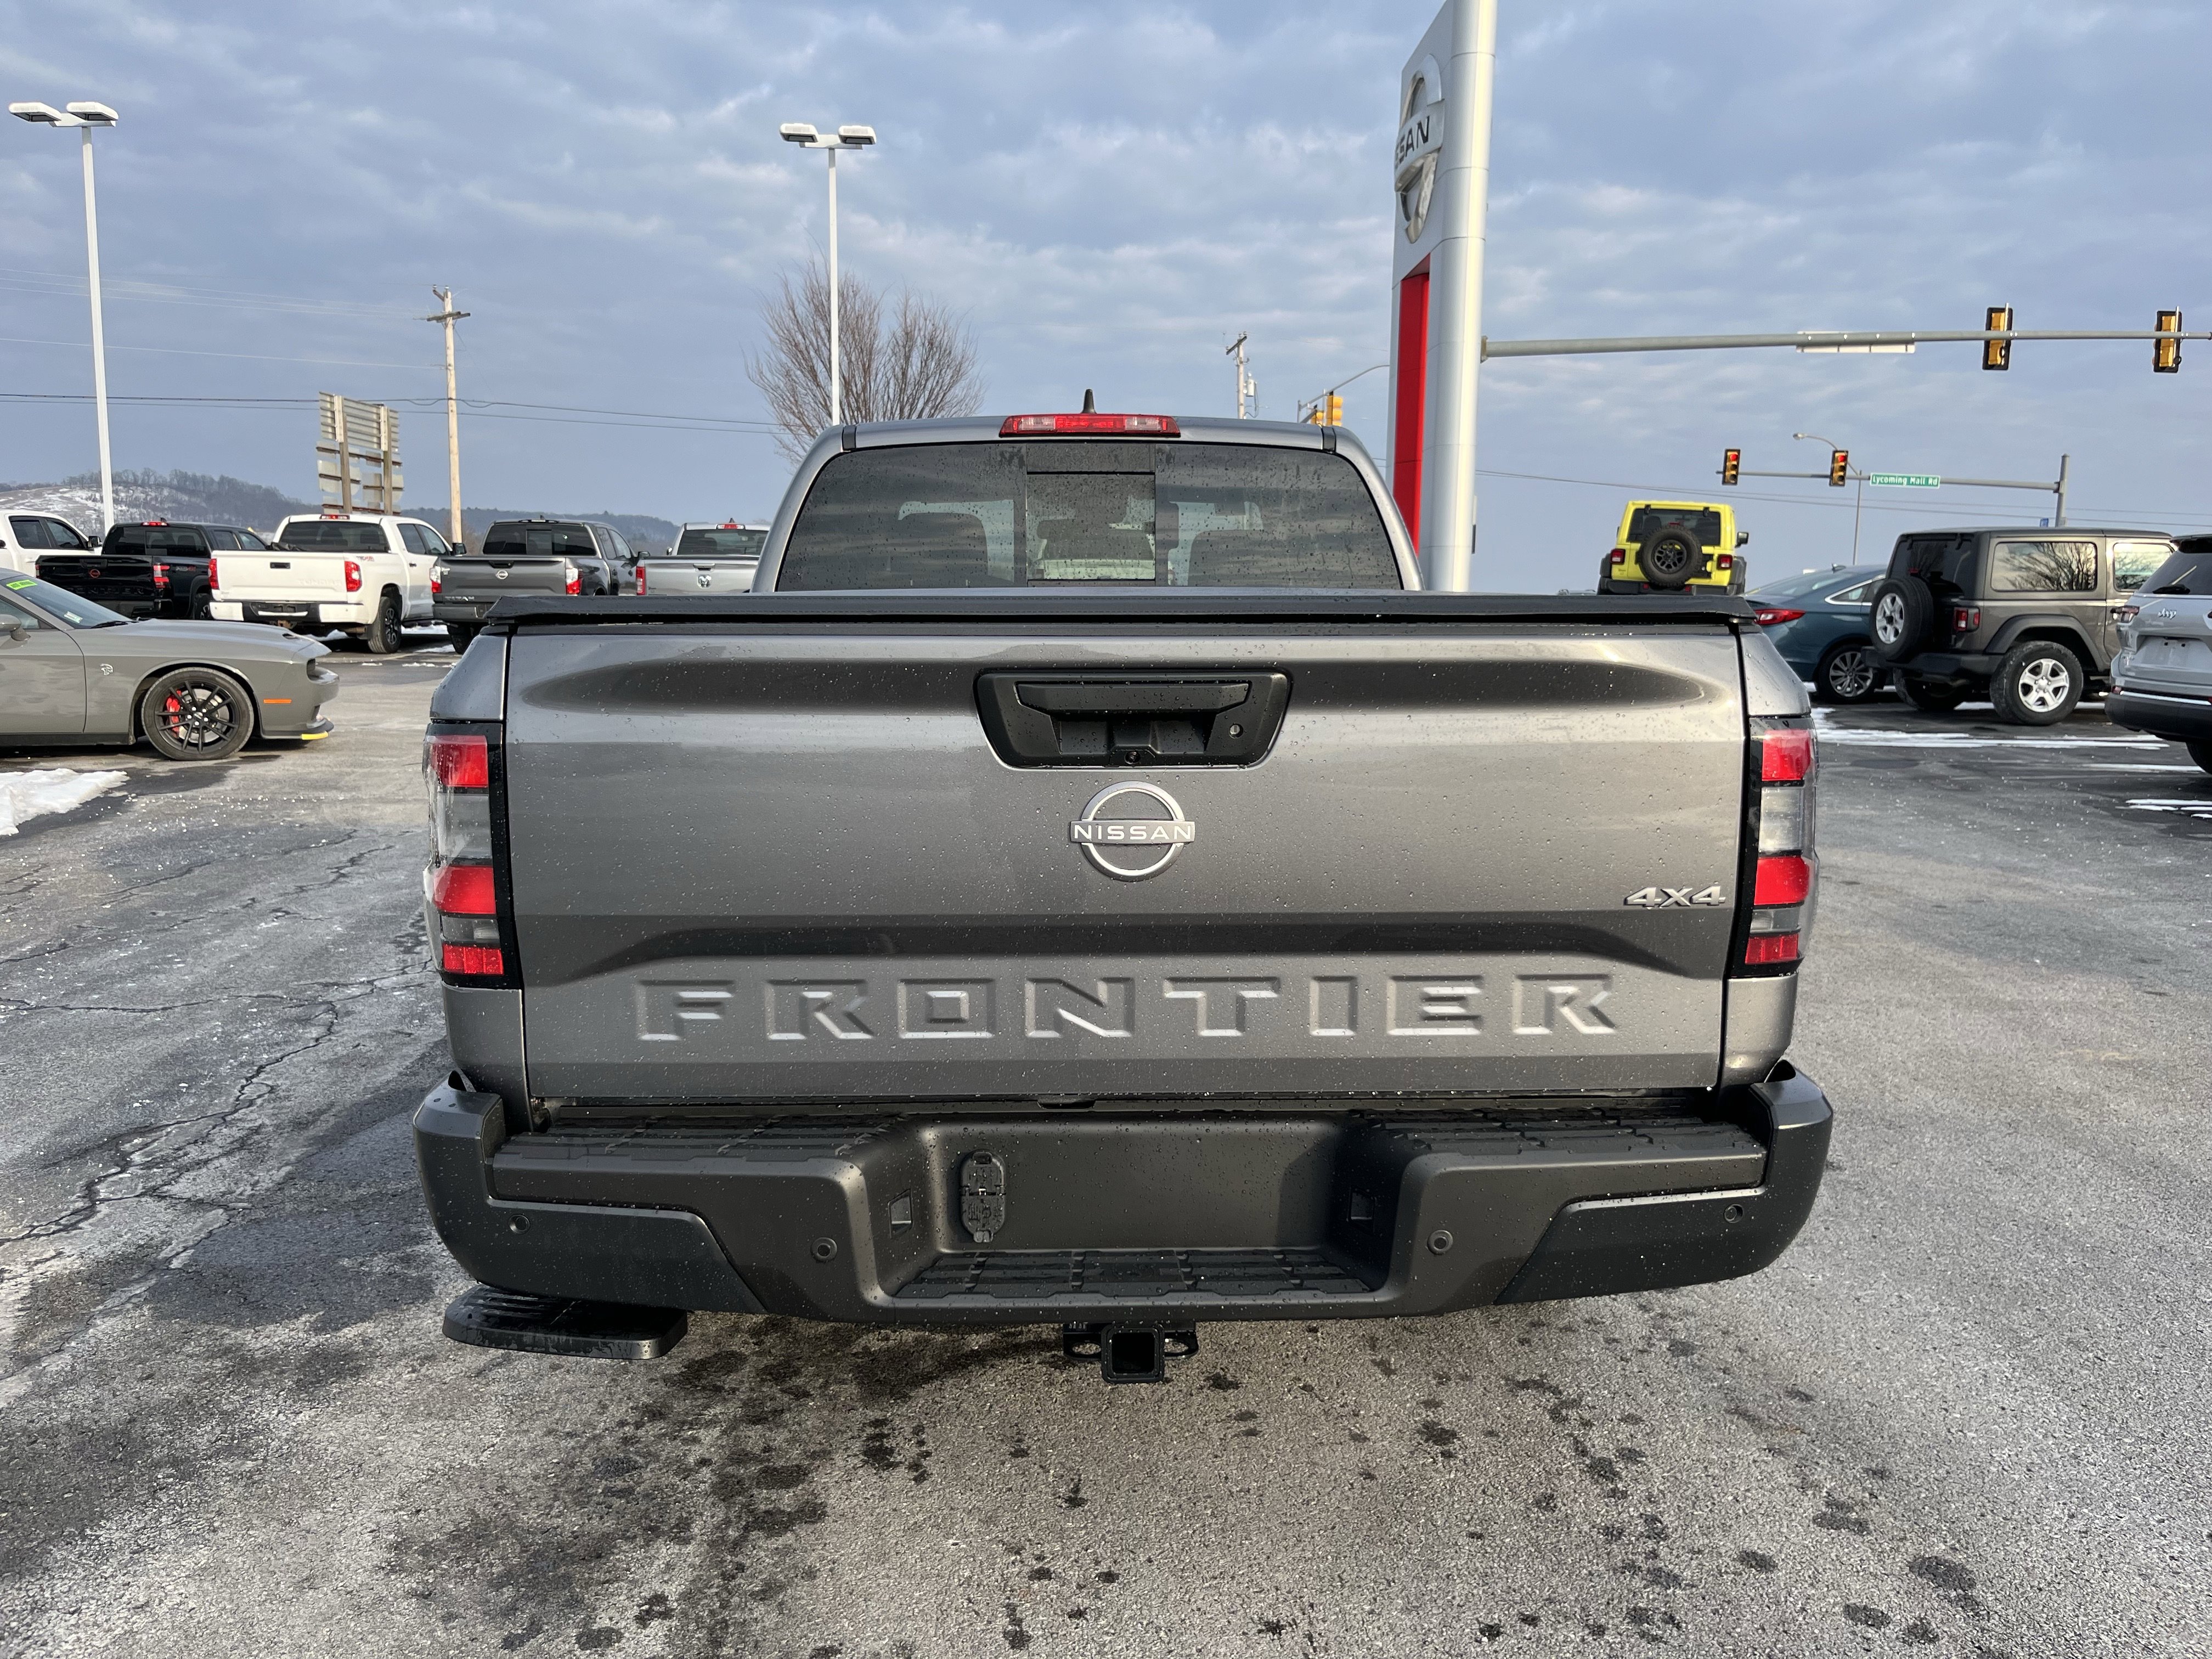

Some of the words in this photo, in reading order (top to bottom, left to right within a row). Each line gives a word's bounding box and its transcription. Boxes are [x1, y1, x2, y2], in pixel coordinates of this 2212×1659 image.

[1395, 115, 1430, 169] SSAN
[1872, 475, 1907, 486] Lycoming
[1910, 477, 1925, 485] Mall
[1928, 477, 1938, 486] Rd
[1074, 825, 1192, 840] NISSAN
[635, 974, 1616, 1041] FRONTIER
